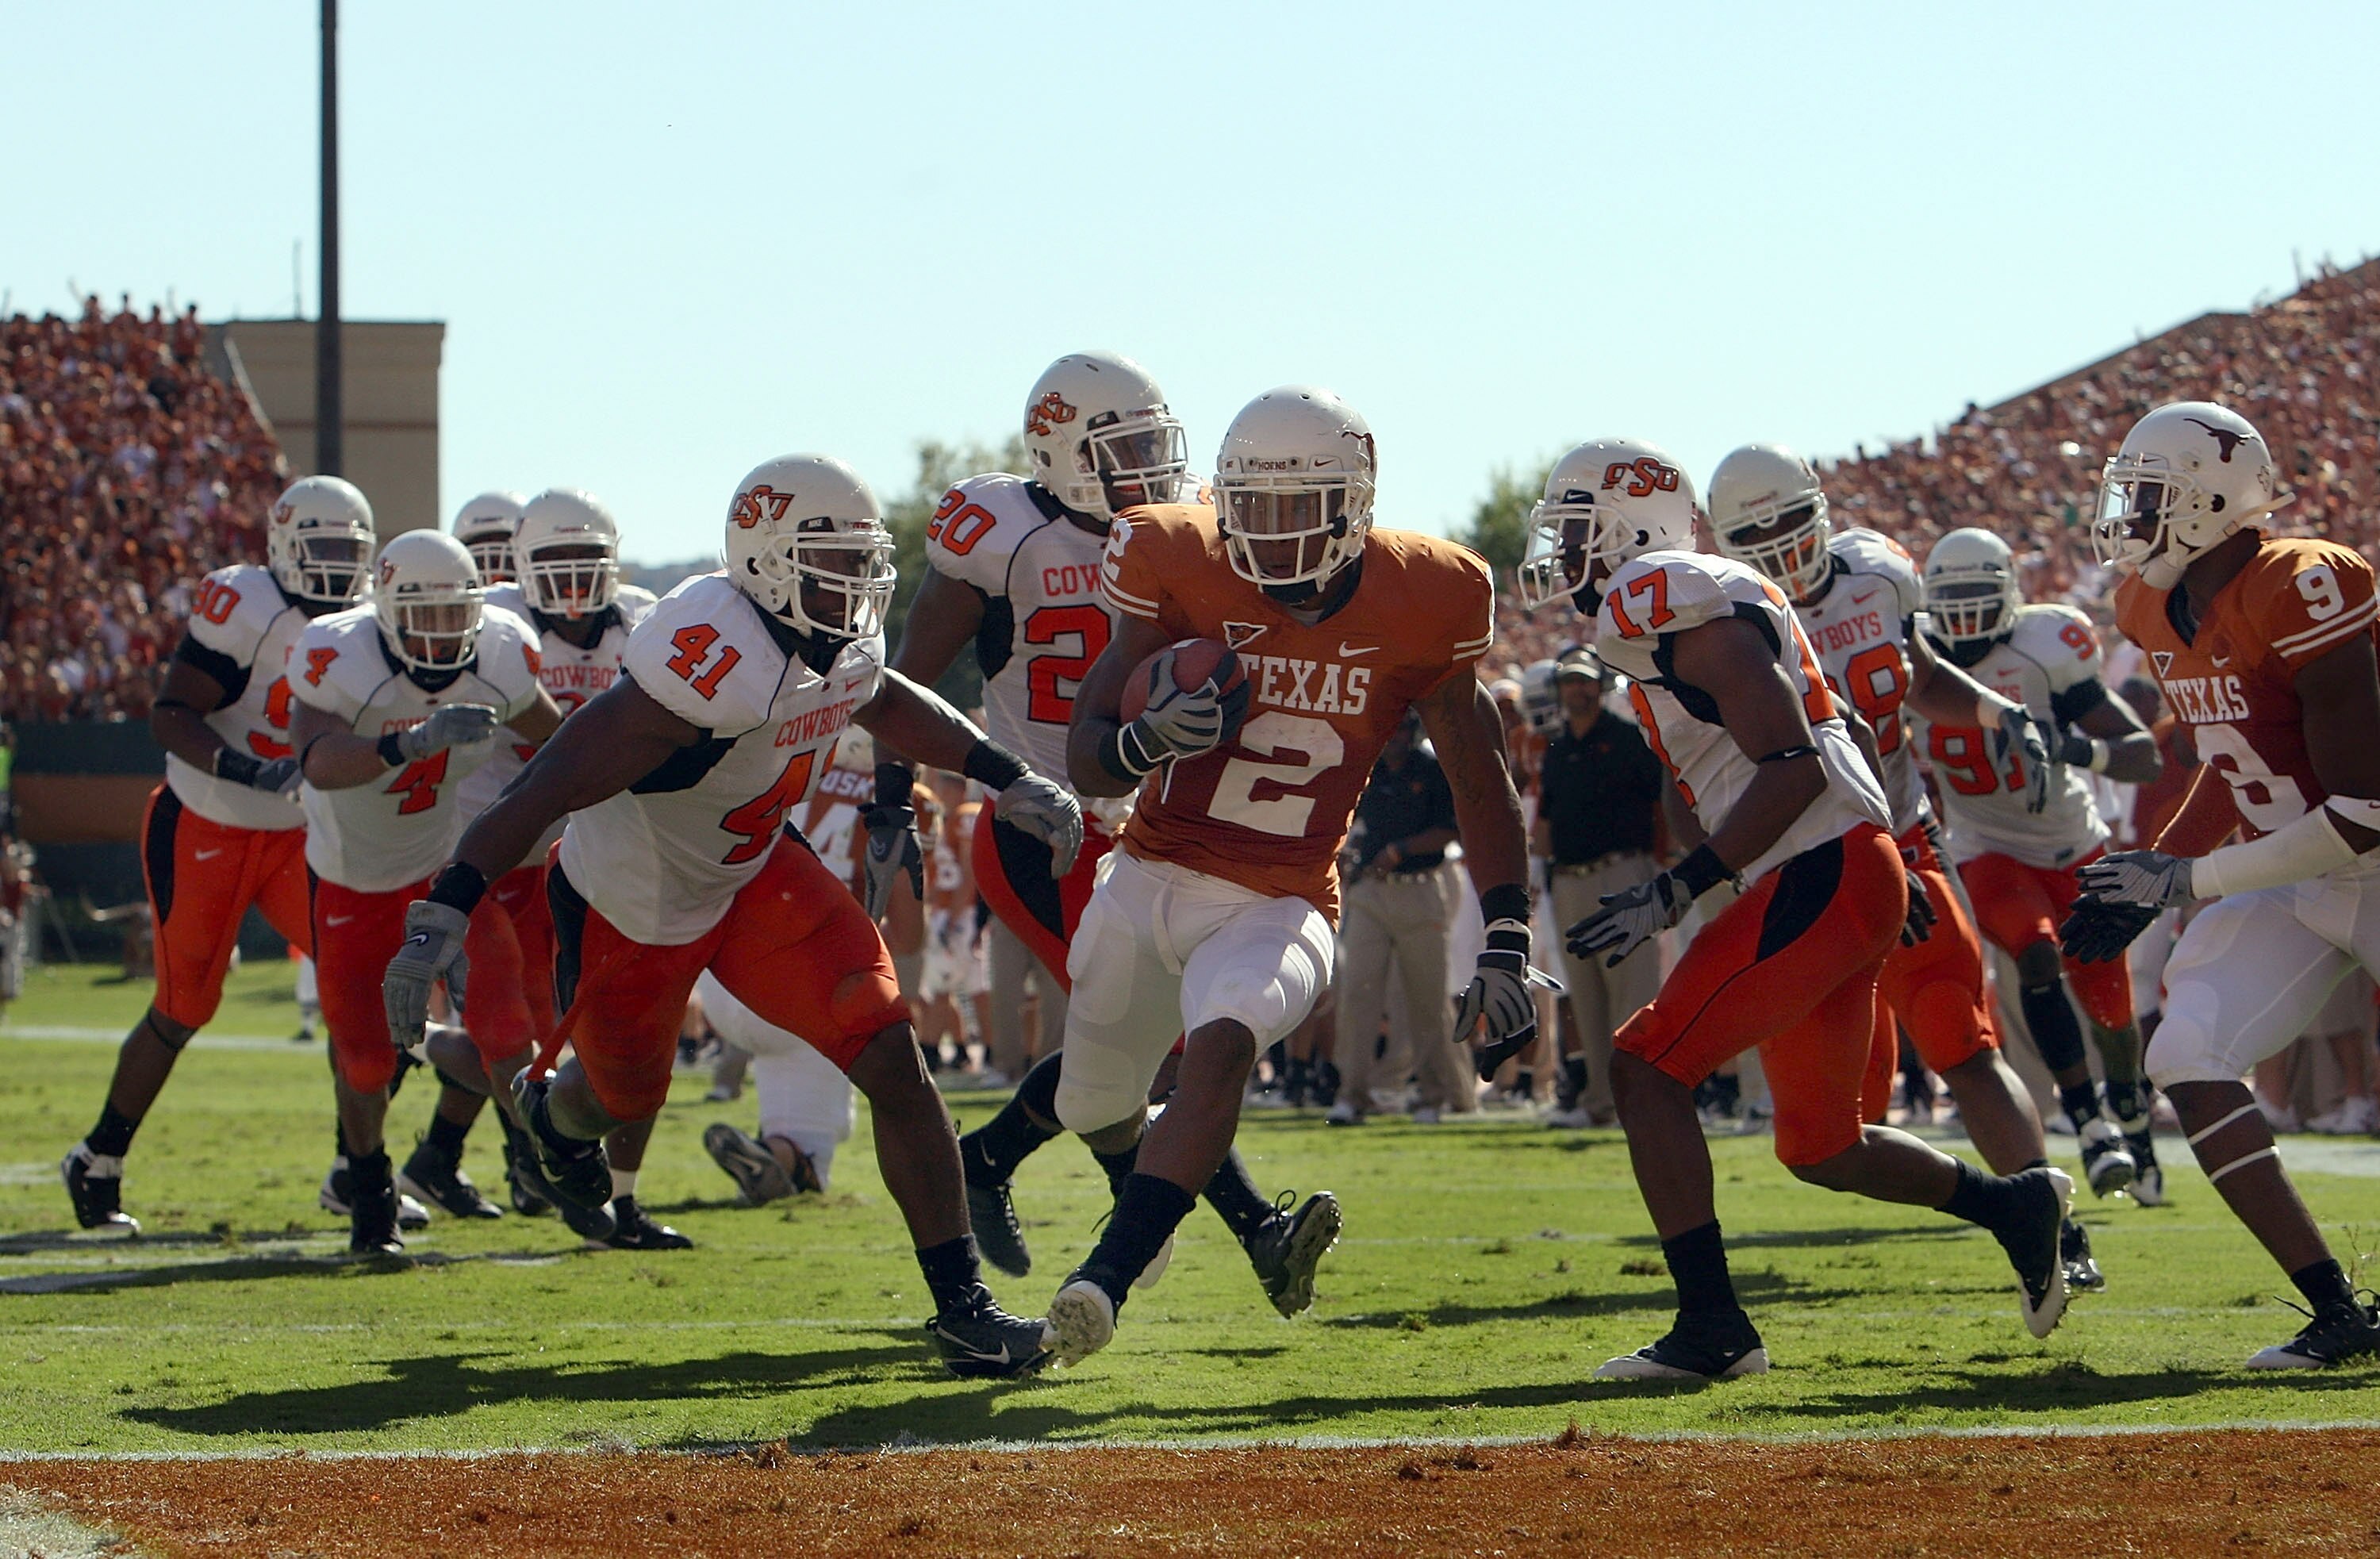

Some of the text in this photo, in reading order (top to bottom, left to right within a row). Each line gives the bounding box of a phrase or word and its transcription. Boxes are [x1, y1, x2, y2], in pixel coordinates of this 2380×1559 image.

[1258, 461, 1287, 470] HORNS
[1601, 456, 1679, 497] OSU
[927, 489, 997, 556] 20
[1102, 517, 1134, 582] 2
[1607, 567, 1676, 639] 17
[2295, 564, 2345, 622] 9
[304, 646, 340, 687] 4
[665, 623, 743, 702] 41
[2060, 618, 2101, 662] 9
[1236, 652, 1372, 716] TEXAS
[2163, 675, 2250, 724] TEXAS
[774, 698, 855, 748] COWBOYS
[385, 747, 443, 816] 4
[1206, 710, 1345, 838] 2
